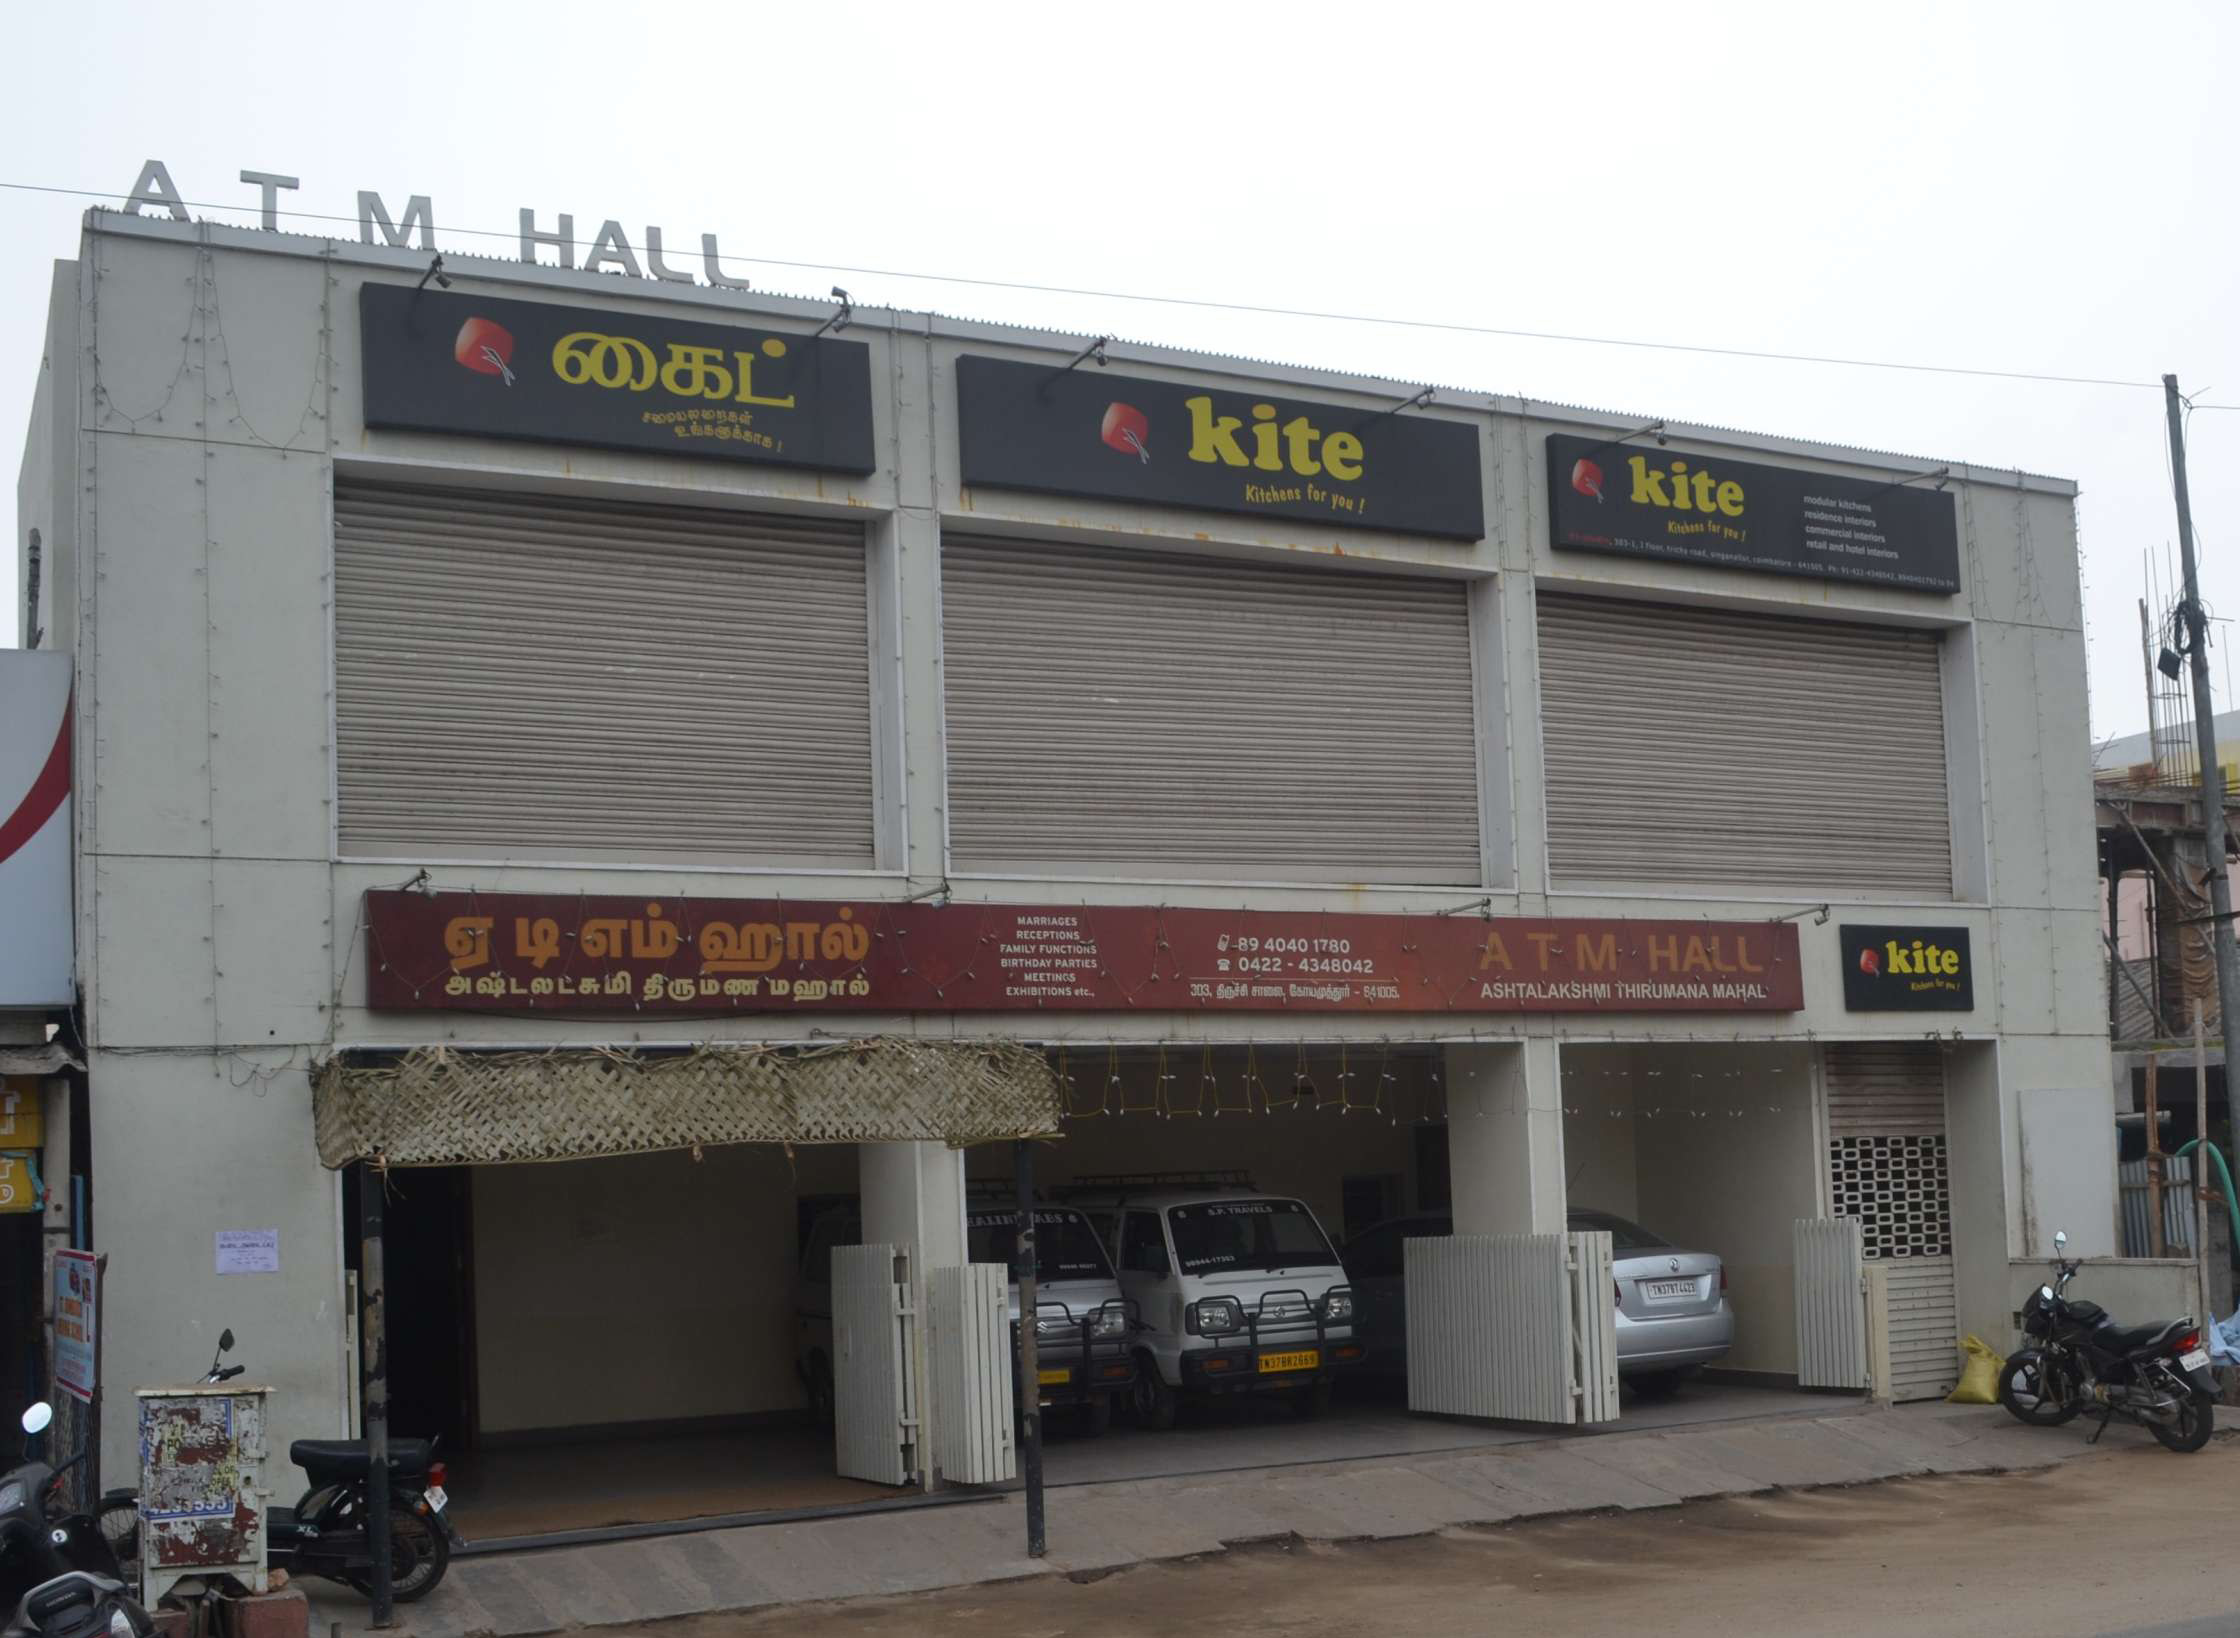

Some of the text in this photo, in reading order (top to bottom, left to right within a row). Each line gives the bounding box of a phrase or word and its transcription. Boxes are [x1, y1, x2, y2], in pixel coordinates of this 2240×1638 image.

[123, 159, 750, 291] A T M HALL
[552, 331, 796, 409] கைட்
[1184, 396, 1365, 482] kite
[1627, 455, 1745, 518] kite
[1245, 483, 1302, 505] Kitchens
[1306, 482, 1328, 503] for
[1331, 493, 1354, 512] you
[1803, 494, 1872, 513] modular kitchens
[1804, 510, 1878, 528] residence interiors
[1667, 519, 1705, 536] Kitchens
[1707, 519, 1722, 533] for
[1723, 527, 1739, 540] you
[1805, 525, 1887, 544] commercial interiors
[1806, 540, 1900, 560] retail and hotel interiors
[1016, 916, 1078, 926] MARRIAGES
[444, 902, 870, 973] ஏ டி எம் ஹால்
[1016, 930, 1080, 940] RECEPTIONS
[1000, 944, 1097, 955] FAMILY FUNCTIONS
[1264, 937, 1308, 953] 4040
[1313, 938, 1351, 954] 1780
[1480, 932, 1764, 972] A T M HALL
[1000, 958, 1098, 969] BIRTHDAY PARTIES
[1238, 956, 1282, 972] 0422
[1298, 958, 1374, 974] 4348042
[1886, 940, 1960, 977] kite
[643, 972, 760, 1001] திருமண
[769, 973, 870, 1001] மஹால்
[1024, 972, 1077, 983] MEETINGS
[1006, 987, 1072, 997] EXHIBITIONS
[1480, 981, 1767, 1000] ASHTALAKSHMI THIRUMANA MAHAL
[1227, 1205, 1273, 1215] TRAVELS
